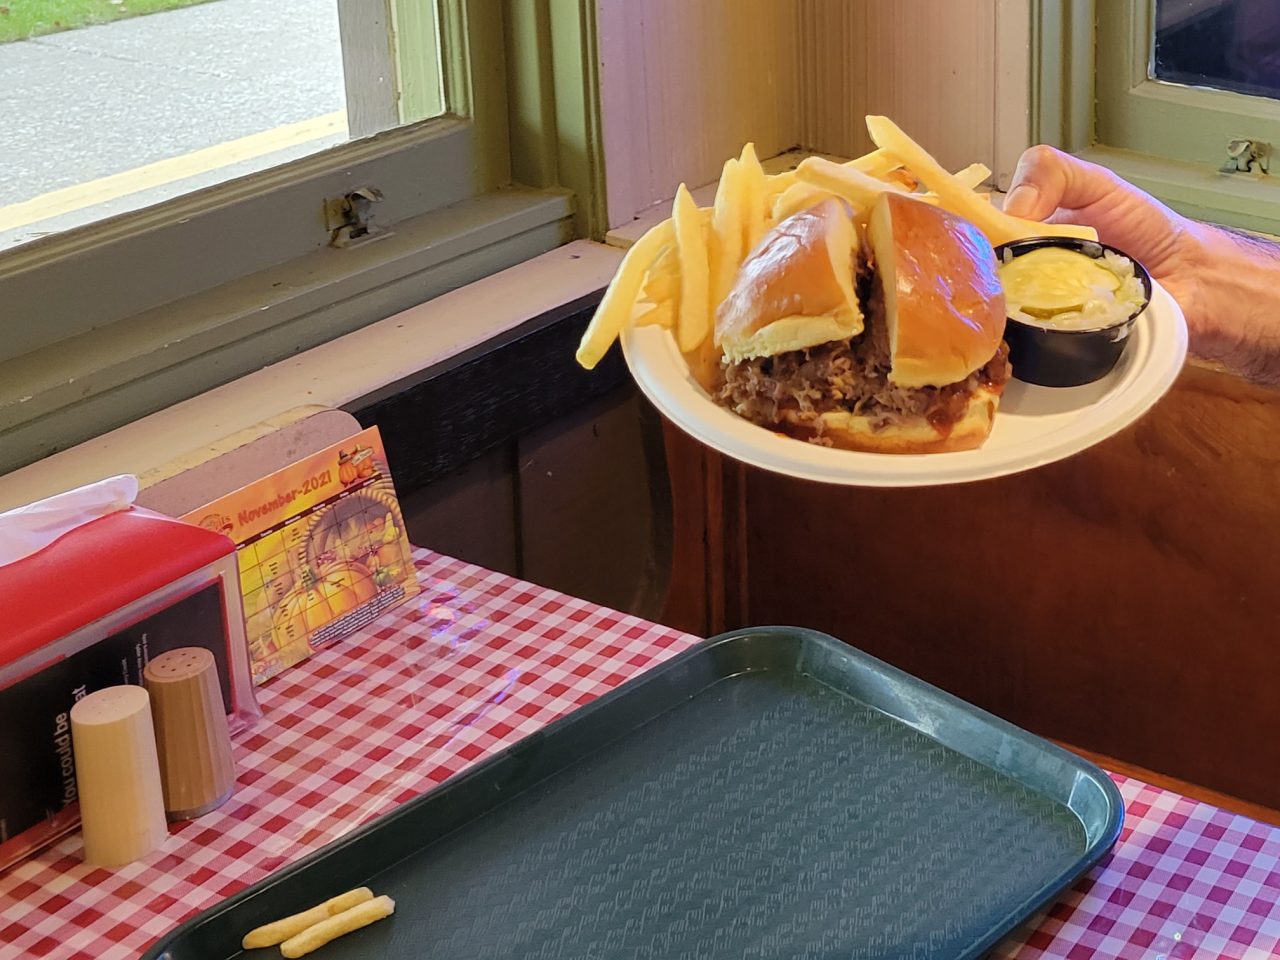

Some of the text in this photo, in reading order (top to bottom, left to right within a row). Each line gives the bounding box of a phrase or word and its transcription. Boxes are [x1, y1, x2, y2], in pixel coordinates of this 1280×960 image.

[237, 469, 332, 527] November-2021
[53, 712, 69, 736] be
[54, 734, 74, 777] could
